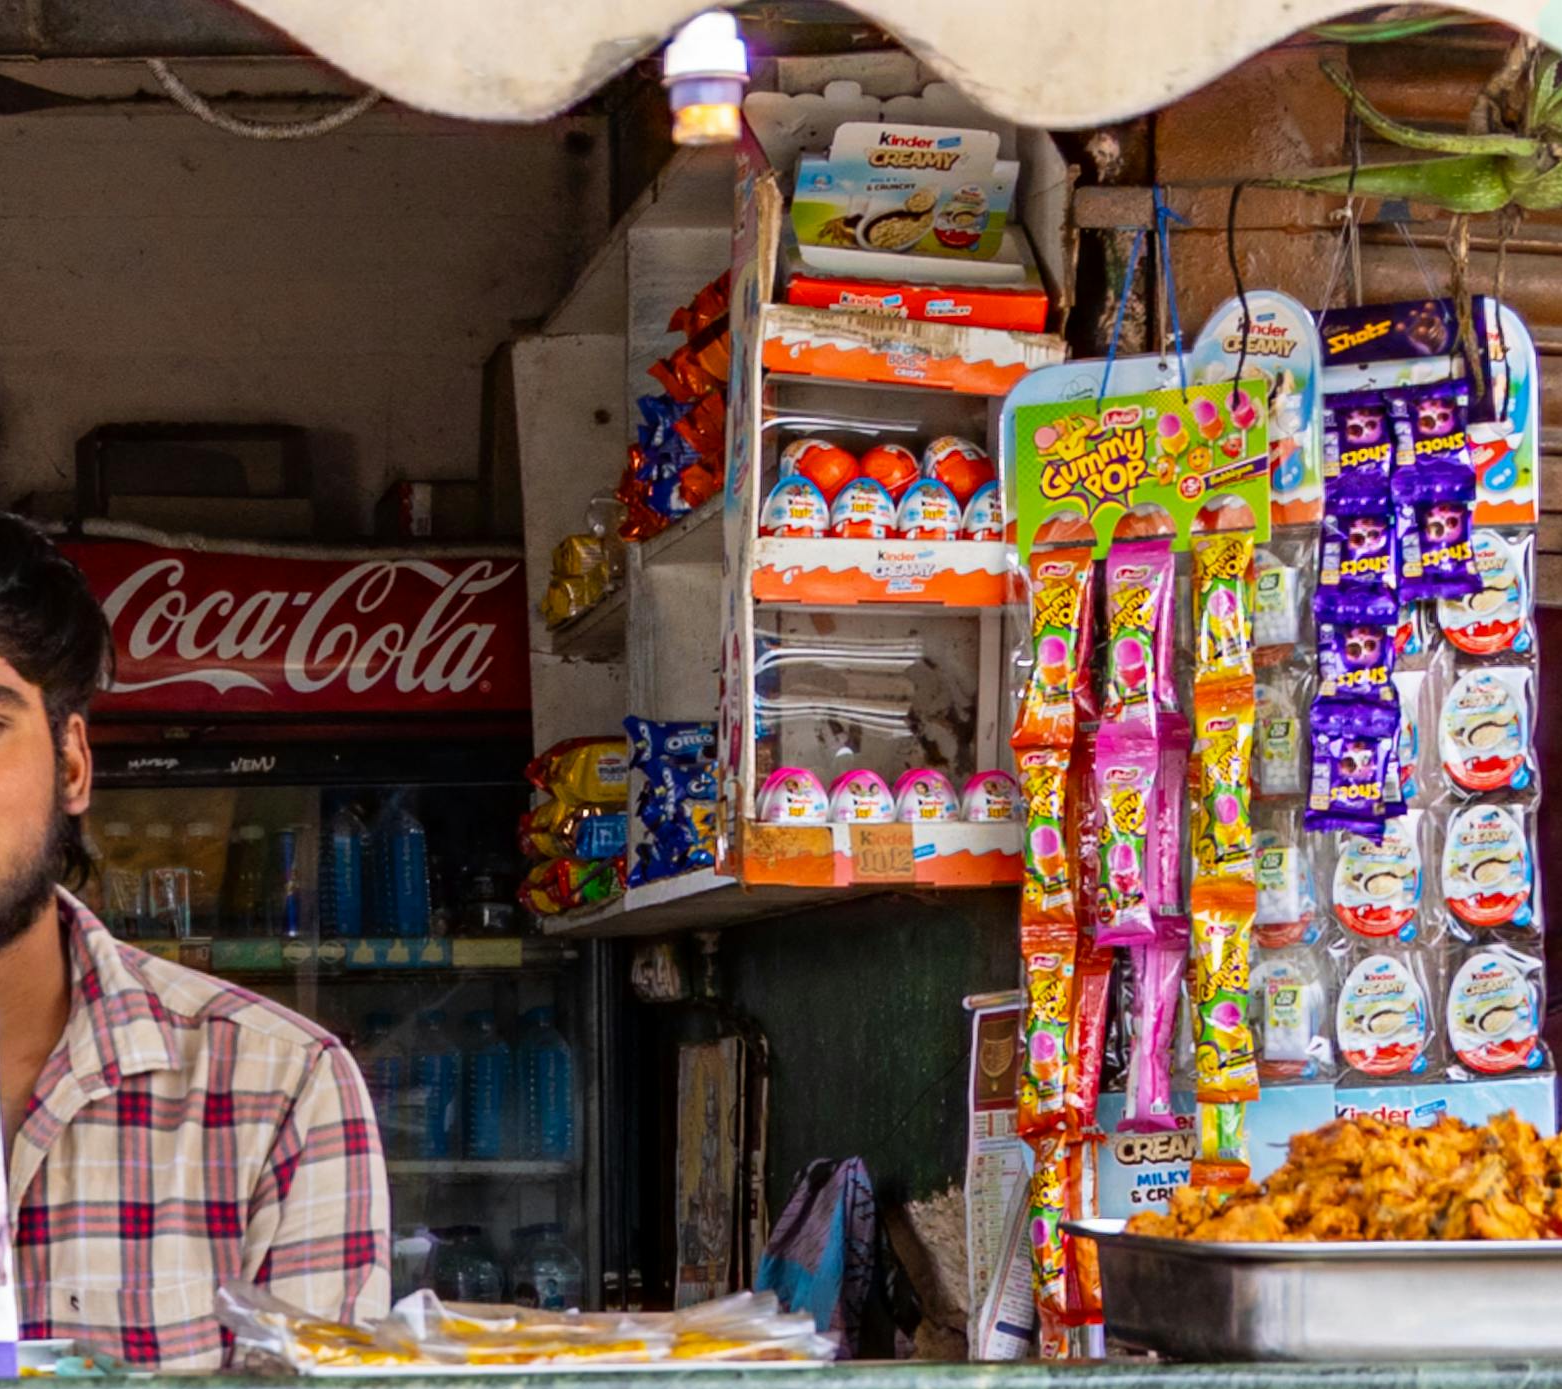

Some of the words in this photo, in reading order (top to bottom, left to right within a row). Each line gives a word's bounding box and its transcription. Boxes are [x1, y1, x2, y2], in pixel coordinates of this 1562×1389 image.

[868, 149, 960, 171] CREAMY
[1329, 319, 1392, 354] Shots
[1341, 442, 1391, 467] Shots
[1415, 432, 1465, 457] Shots
[1041, 427, 1146, 500] Gummy
[1083, 460, 1147, 499] POP
[1341, 555, 1390, 576] Shots
[100, 557, 520, 694] Coca-Cola
[1331, 782, 1381, 801] Shots
[1136, 1170, 1190, 1188] MILKY
